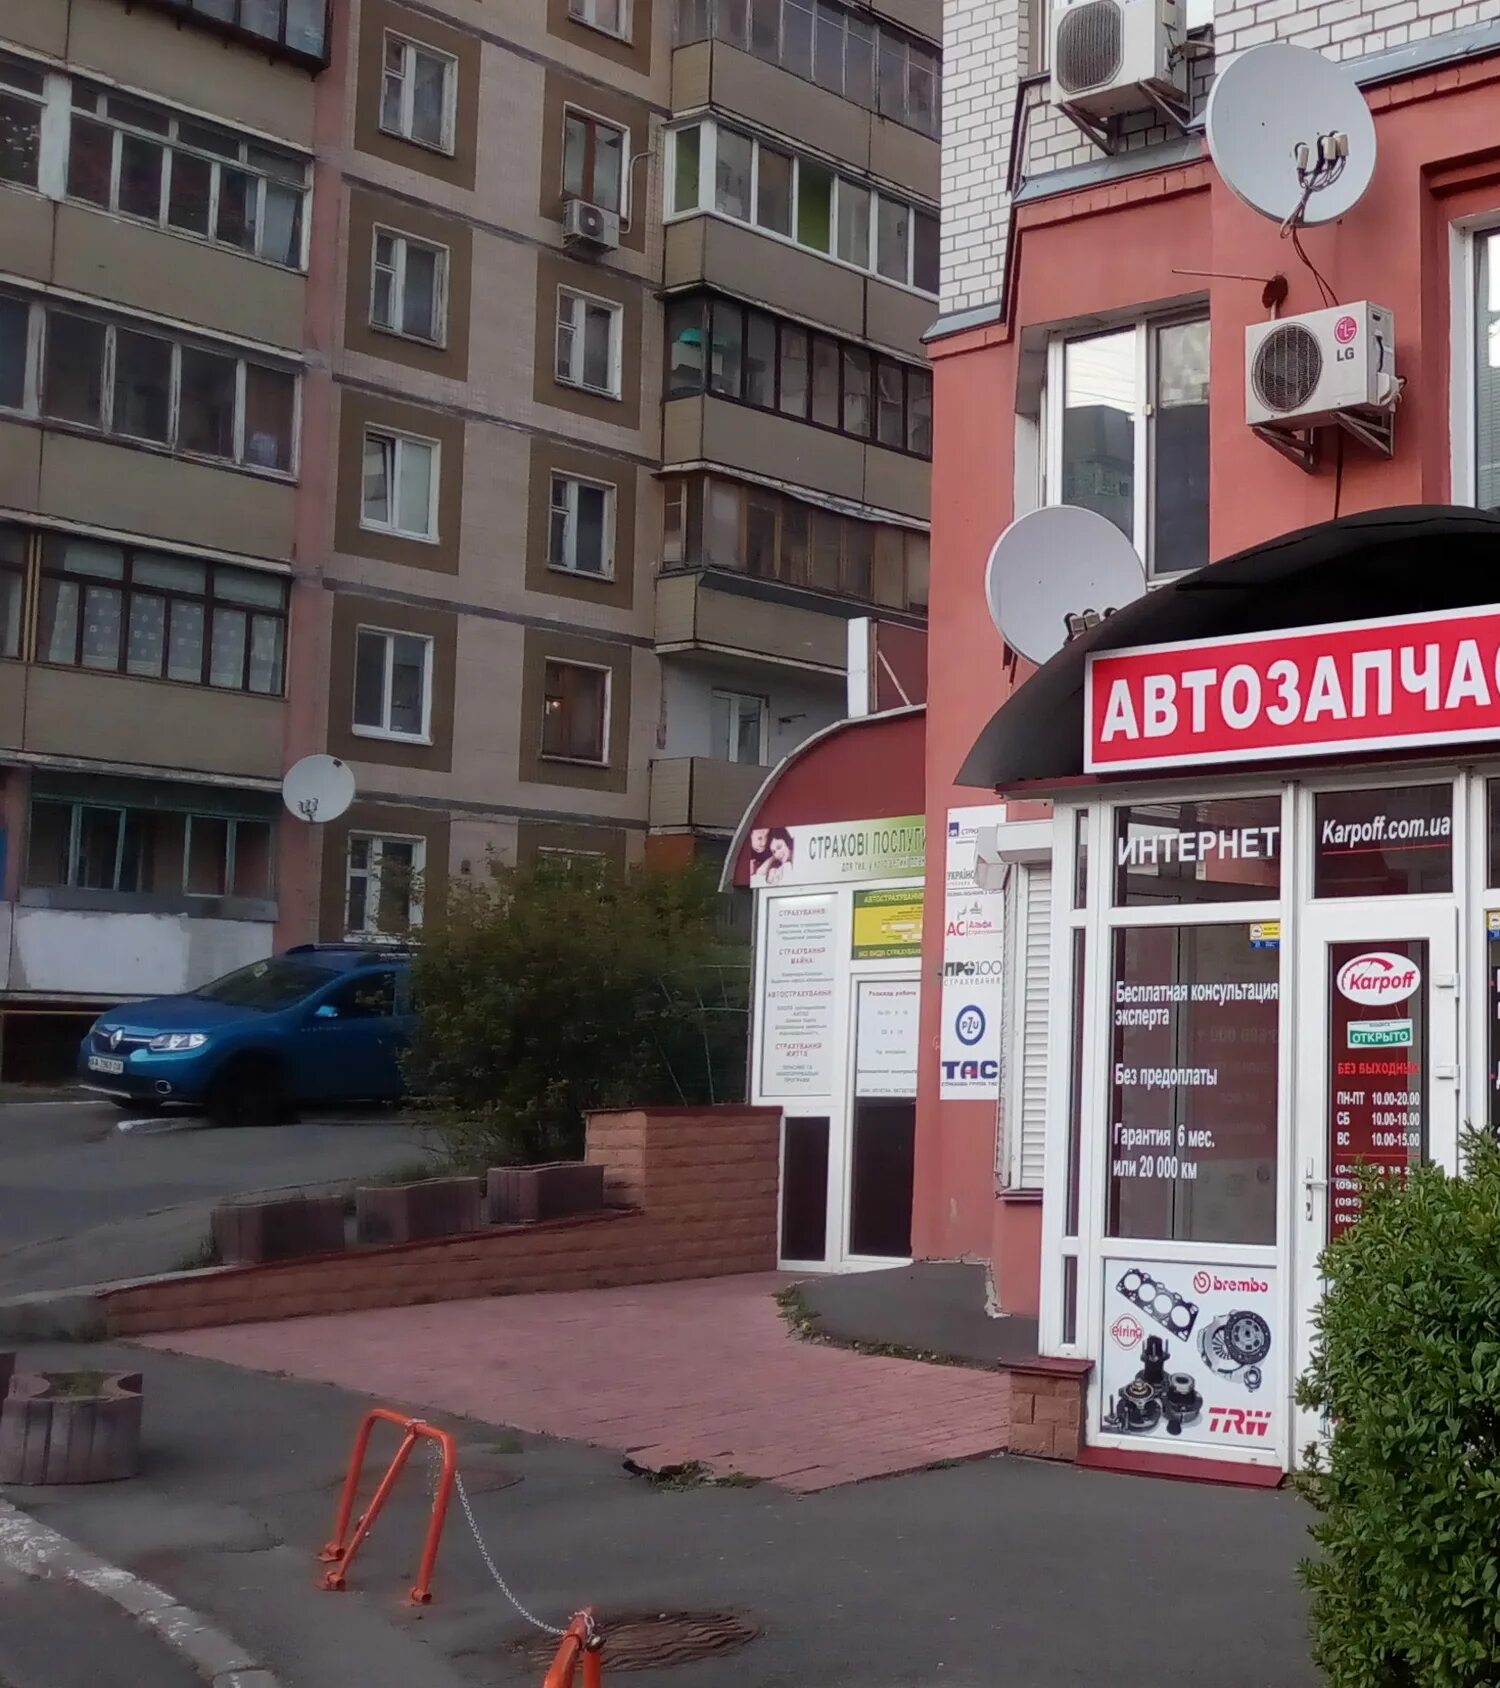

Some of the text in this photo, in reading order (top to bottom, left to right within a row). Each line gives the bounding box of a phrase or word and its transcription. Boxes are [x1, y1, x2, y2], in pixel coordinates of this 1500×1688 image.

[1336, 347, 1355, 362] LG
[1322, 815, 1451, 849] Karpoff.com.ua
[809, 833, 869, 860] СТРАХОВІ
[1118, 826, 1280, 866] ИНТЕРНЕТ
[1349, 970, 1416, 994] Karpoff
[1116, 981, 1279, 1007] Бесплатная консультация
[962, 1016, 979, 1034] PZU
[1115, 1008, 1170, 1031] эксперта
[1352, 1031, 1408, 1044] ОТКРЫТО
[942, 1060, 998, 1080] ТАС
[1115, 1063, 1218, 1090] Без предоплаты
[1337, 1062, 1356, 1075] БЕЗ
[1336, 1091, 1420, 1106] ПН-ПТ 10.00-20.00
[1336, 1111, 1420, 1127] СБ 10.00-18.00
[1114, 1123, 1216, 1150] Гарантия 6 мес.
[1336, 1132, 1420, 1147] ВС 10.00-15.00
[1113, 1155, 1198, 1179] или 20 000 км
[1214, 1277, 1268, 1292] brembo
[1112, 1326, 1142, 1339] elring
[1208, 1407, 1272, 1436] TRW
